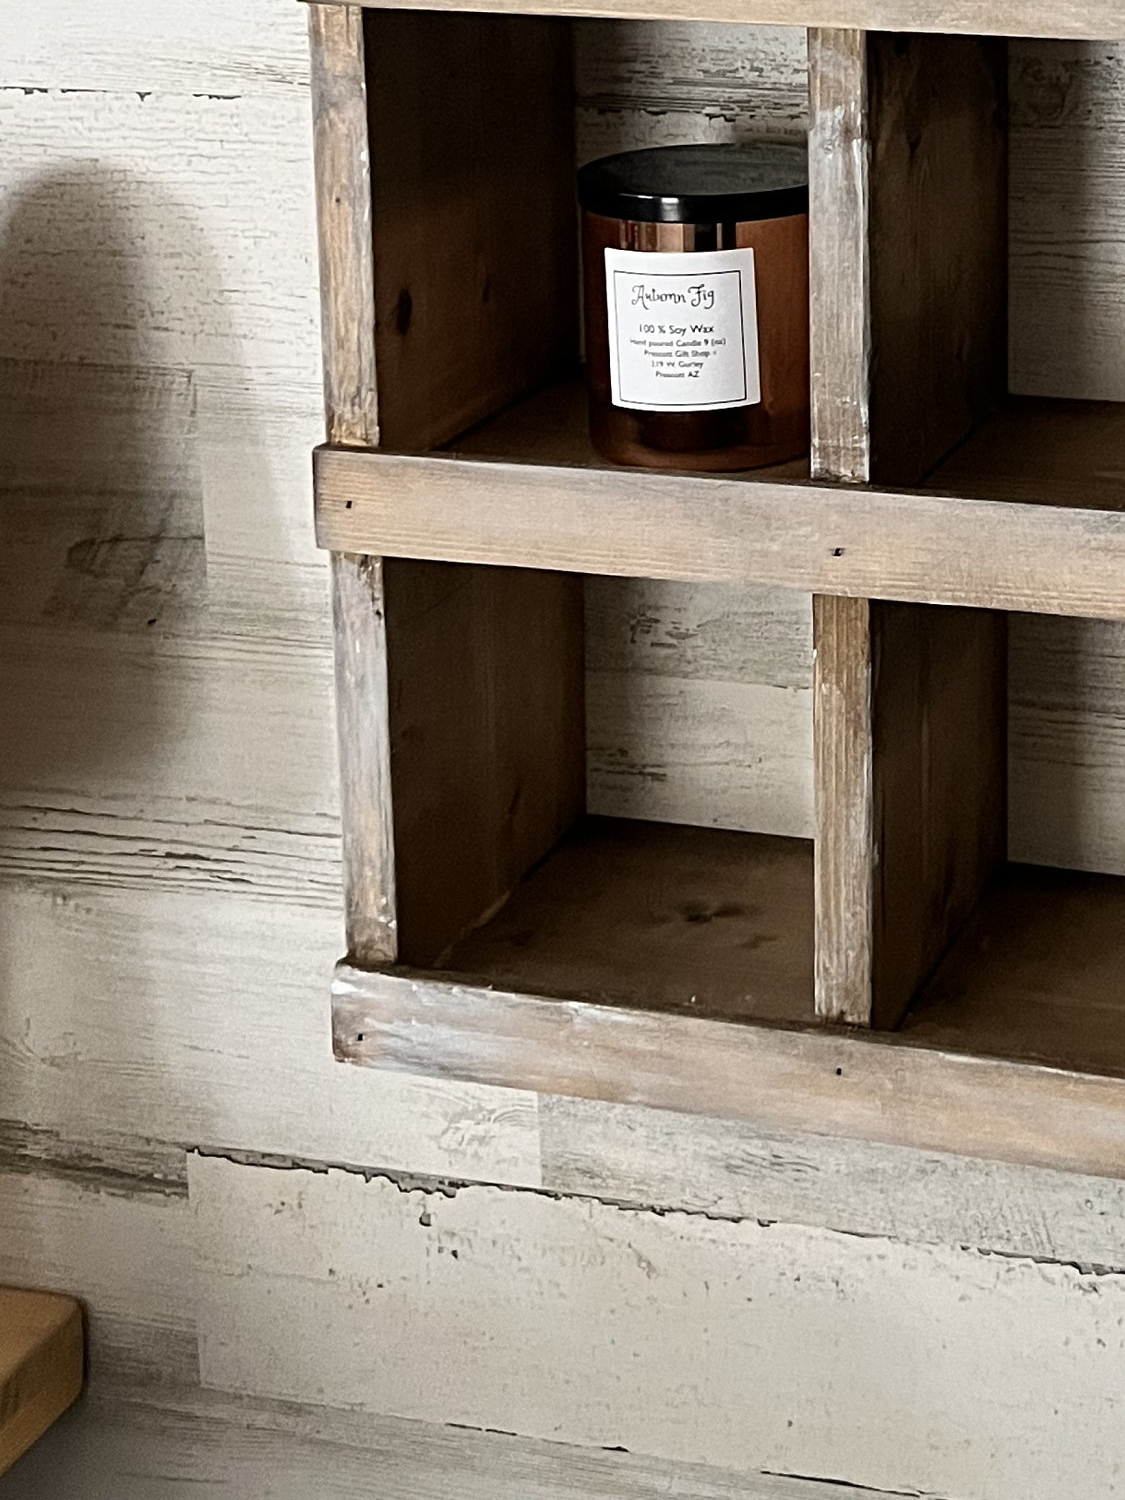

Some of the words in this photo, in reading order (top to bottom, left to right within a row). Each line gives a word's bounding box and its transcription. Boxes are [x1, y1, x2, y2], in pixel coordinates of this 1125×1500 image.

[687, 283, 715, 310] Fig
[639, 324, 655, 334] 100
[657, 324, 666, 334] %
[668, 325, 687, 337] Soy
[690, 324, 715, 334] Wax
[687, 370, 700, 378] AZ
